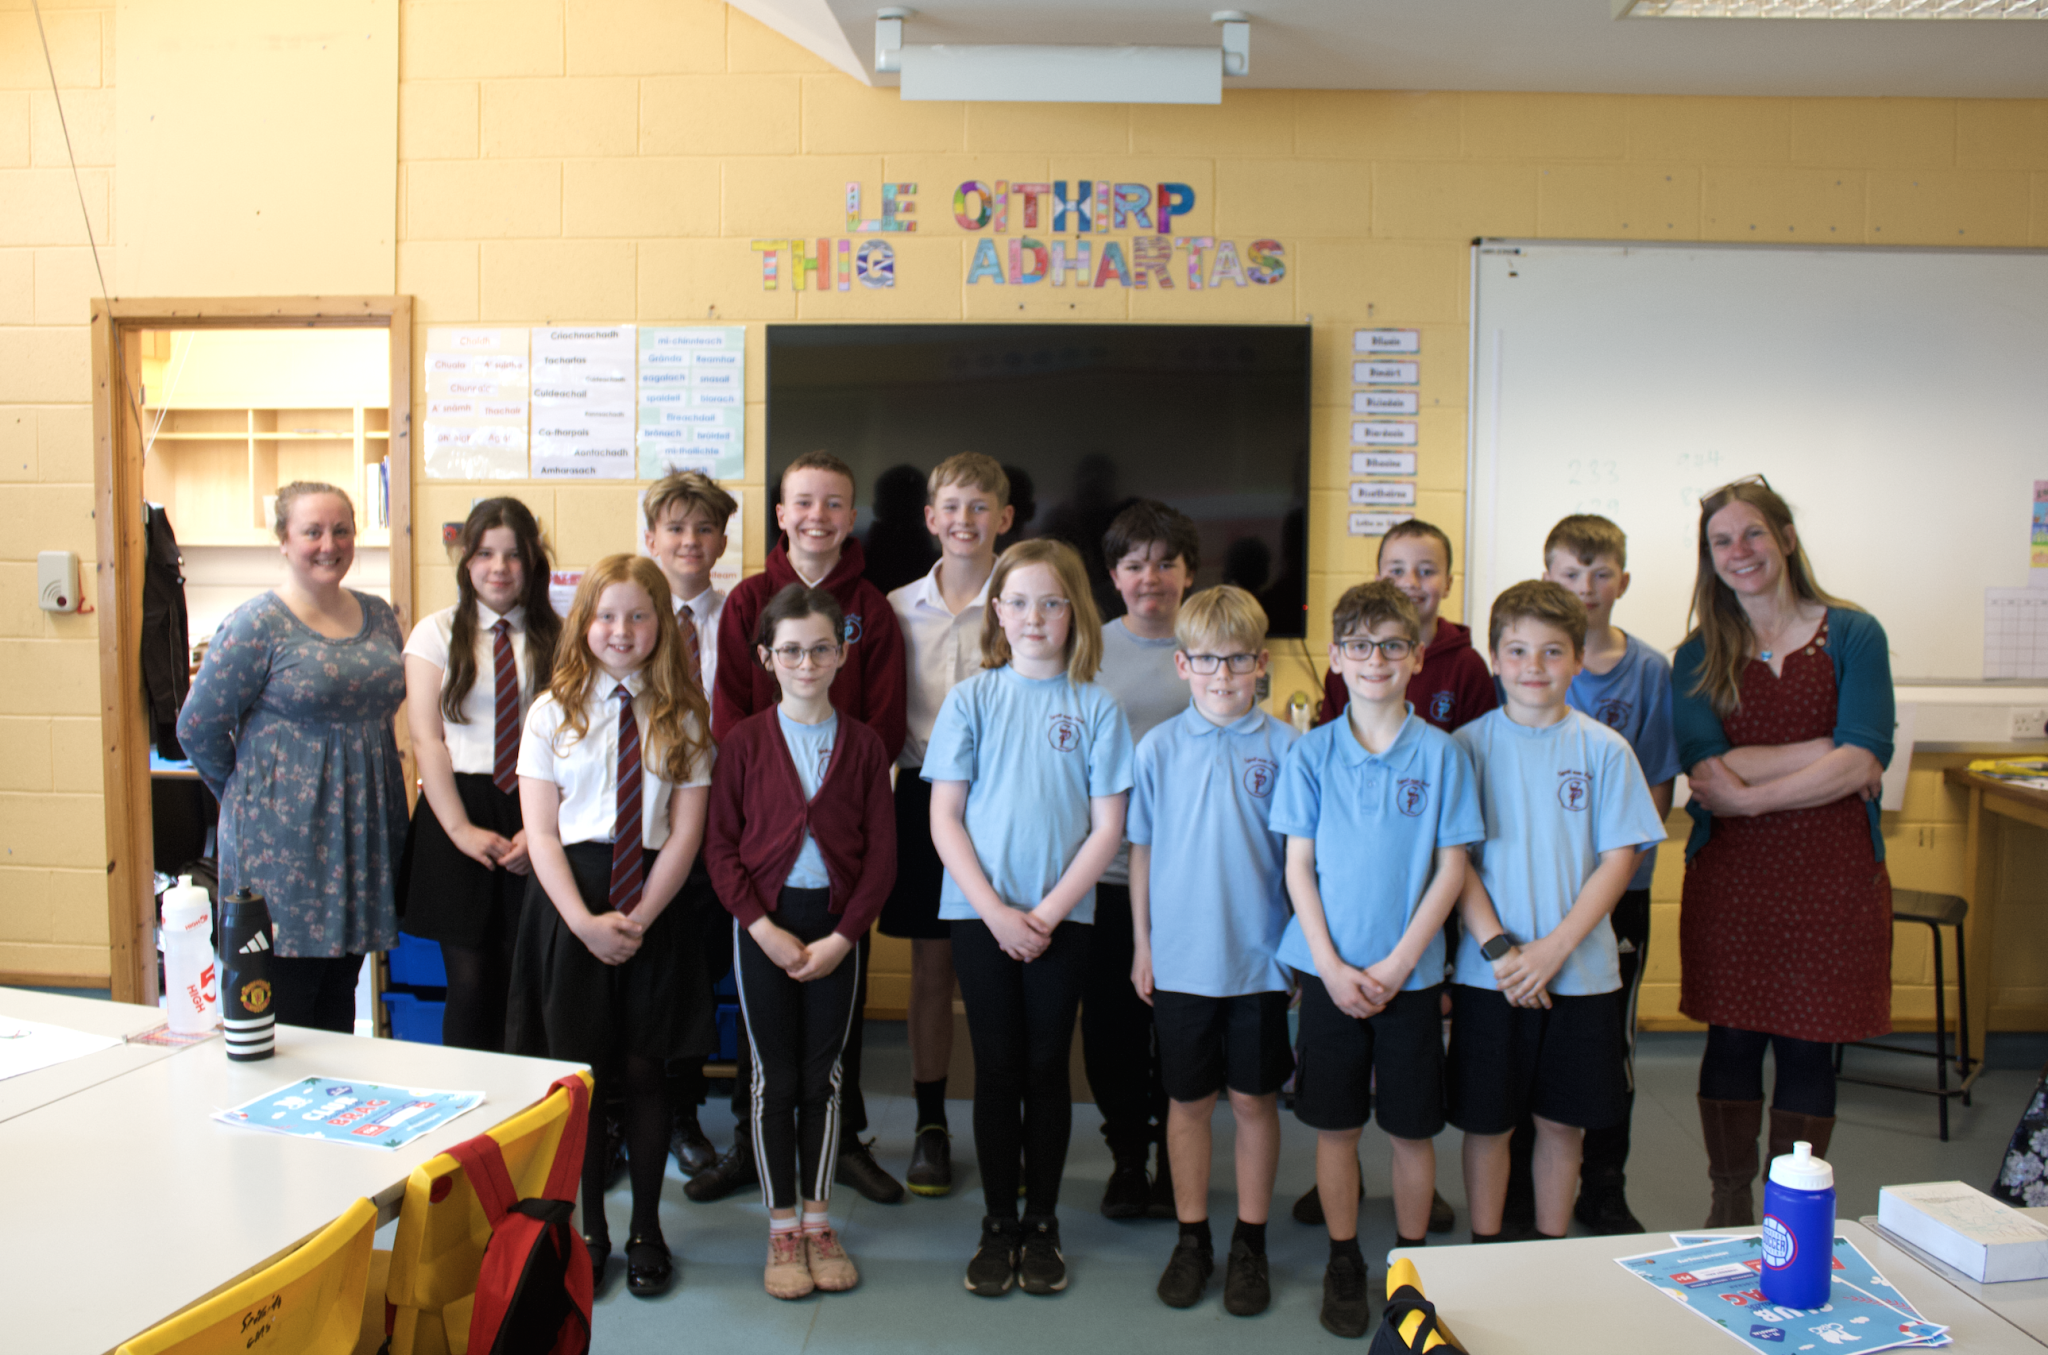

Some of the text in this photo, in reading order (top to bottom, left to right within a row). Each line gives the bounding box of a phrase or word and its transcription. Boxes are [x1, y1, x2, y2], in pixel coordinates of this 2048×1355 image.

[845, 179, 1197, 235] LE OITHIRP
[750, 235, 1287, 292] THIG ADHARTAS
[186, 961, 217, 1014] HIGH 5
